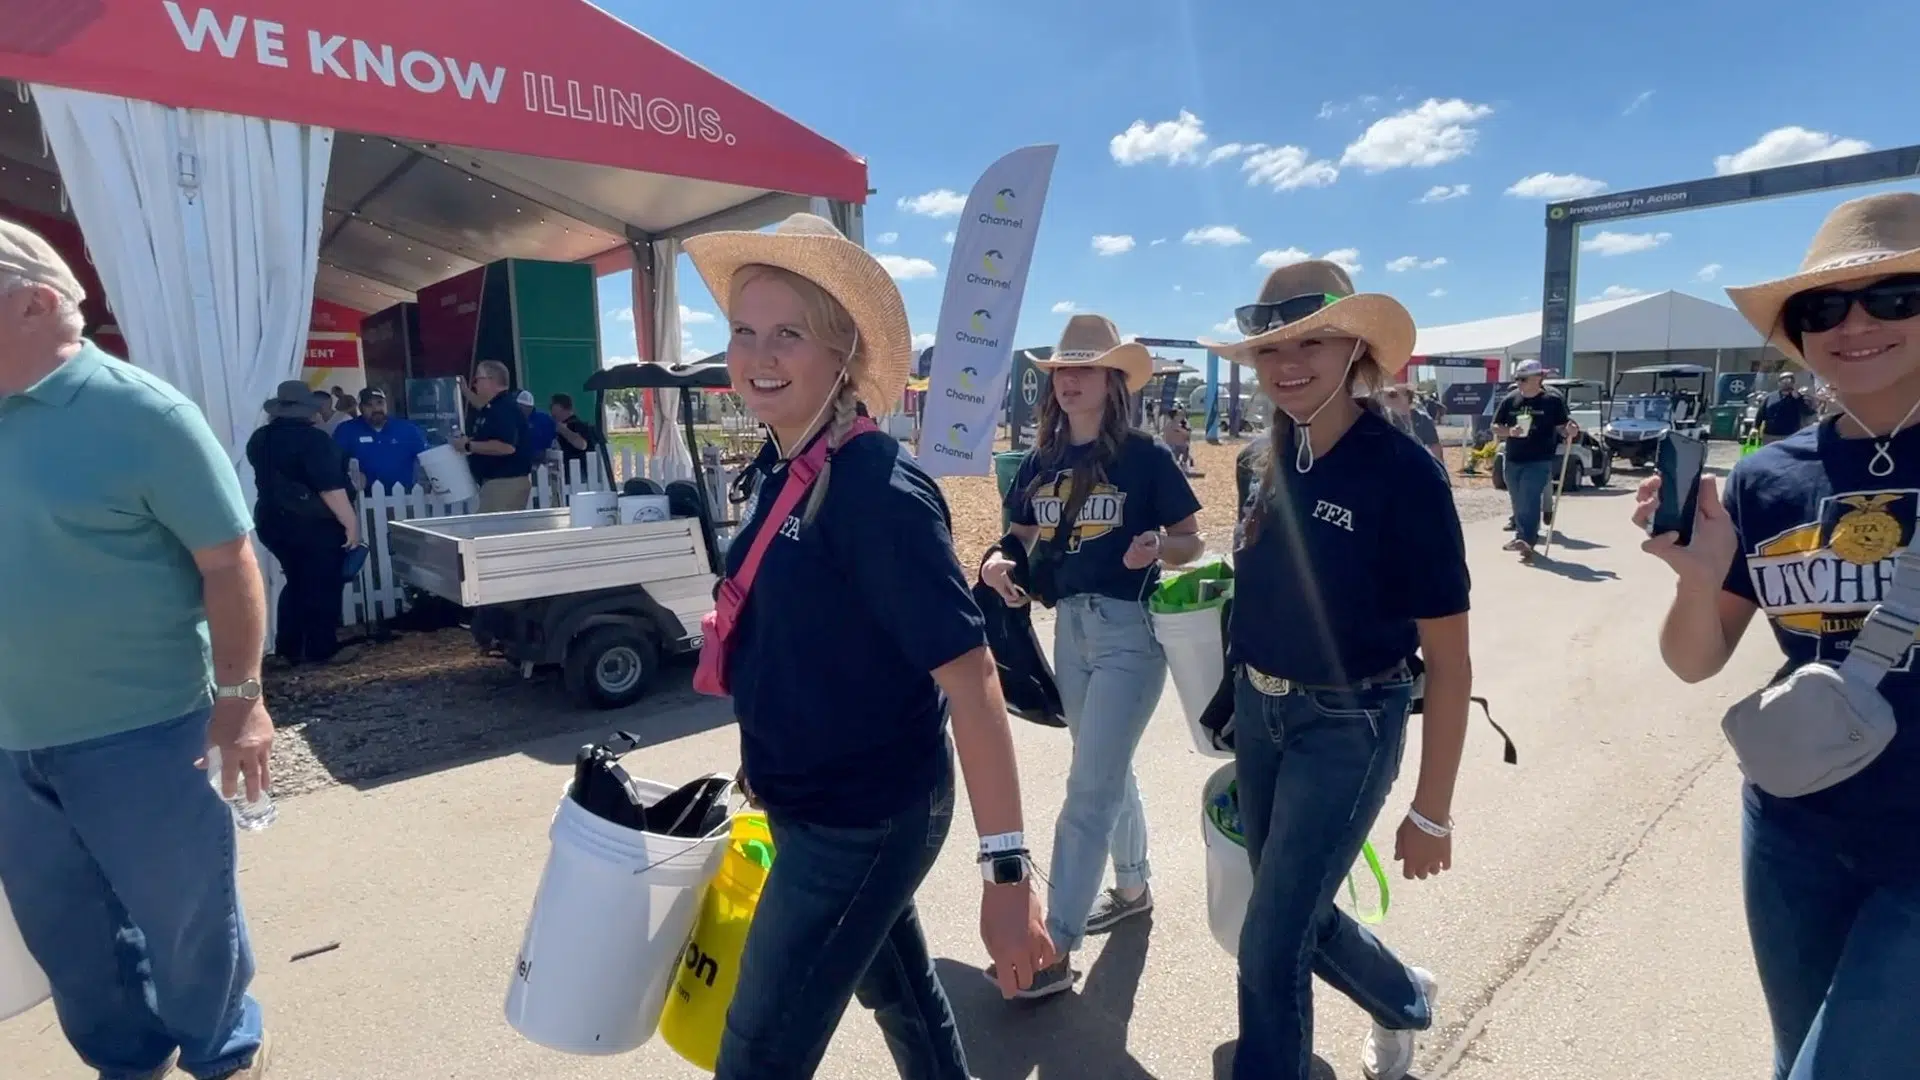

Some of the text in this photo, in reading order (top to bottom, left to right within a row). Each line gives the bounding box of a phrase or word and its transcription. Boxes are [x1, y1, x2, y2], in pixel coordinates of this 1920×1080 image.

[162, 0, 737, 145] WE KNOW ILLINOIS.
[1569, 200, 1630, 215] Innovation
[1646, 191, 1687, 204] Action
[978, 213, 1023, 229] Channel
[966, 273, 1012, 289] Channel
[955, 331, 999, 348] Channel
[945, 388, 985, 405] Channel
[933, 443, 973, 460] Channel
[1312, 500, 1354, 531] FFA
[1853, 524, 1878, 534] FFA
[1753, 556, 1896, 607] LITCHF
[1823, 617, 1865, 633] ILLIN
